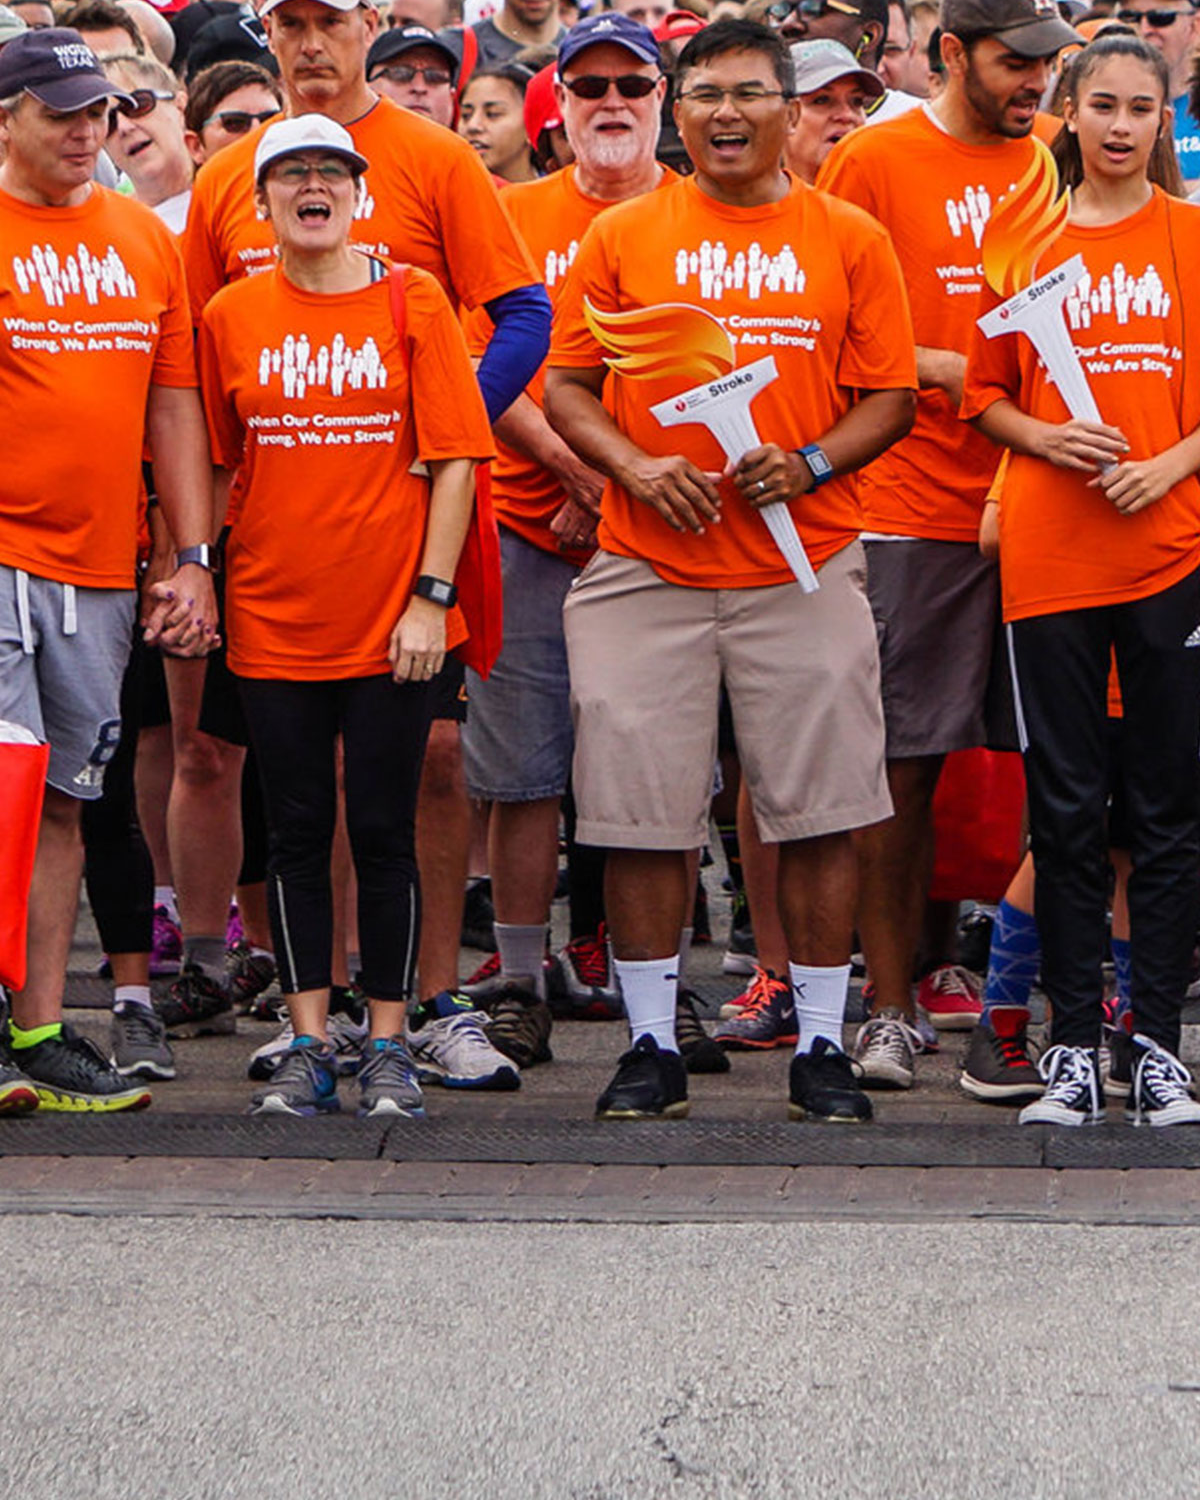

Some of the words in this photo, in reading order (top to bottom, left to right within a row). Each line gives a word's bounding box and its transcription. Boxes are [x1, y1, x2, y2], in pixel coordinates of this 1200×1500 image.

[936, 265, 975, 279] When
[945, 281, 982, 295] Stron
[1027, 271, 1066, 301] Stroke
[3, 317, 46, 332] When
[48, 319, 71, 334] Our
[73, 319, 150, 336] Community
[728, 314, 811, 333] Community
[12, 335, 60, 354] Strong,
[62, 337, 85, 351] We
[87, 337, 113, 350] Are
[740, 332, 768, 345] Are
[770, 331, 816, 352] Strong
[1086, 361, 1111, 374] We
[1113, 359, 1140, 372] Are
[708, 372, 753, 397] Stroke
[282, 413, 310, 428] Our
[312, 411, 391, 428] Community
[257, 431, 296, 448] trong,
[298, 431, 322, 445] We
[324, 430, 352, 445] Are
